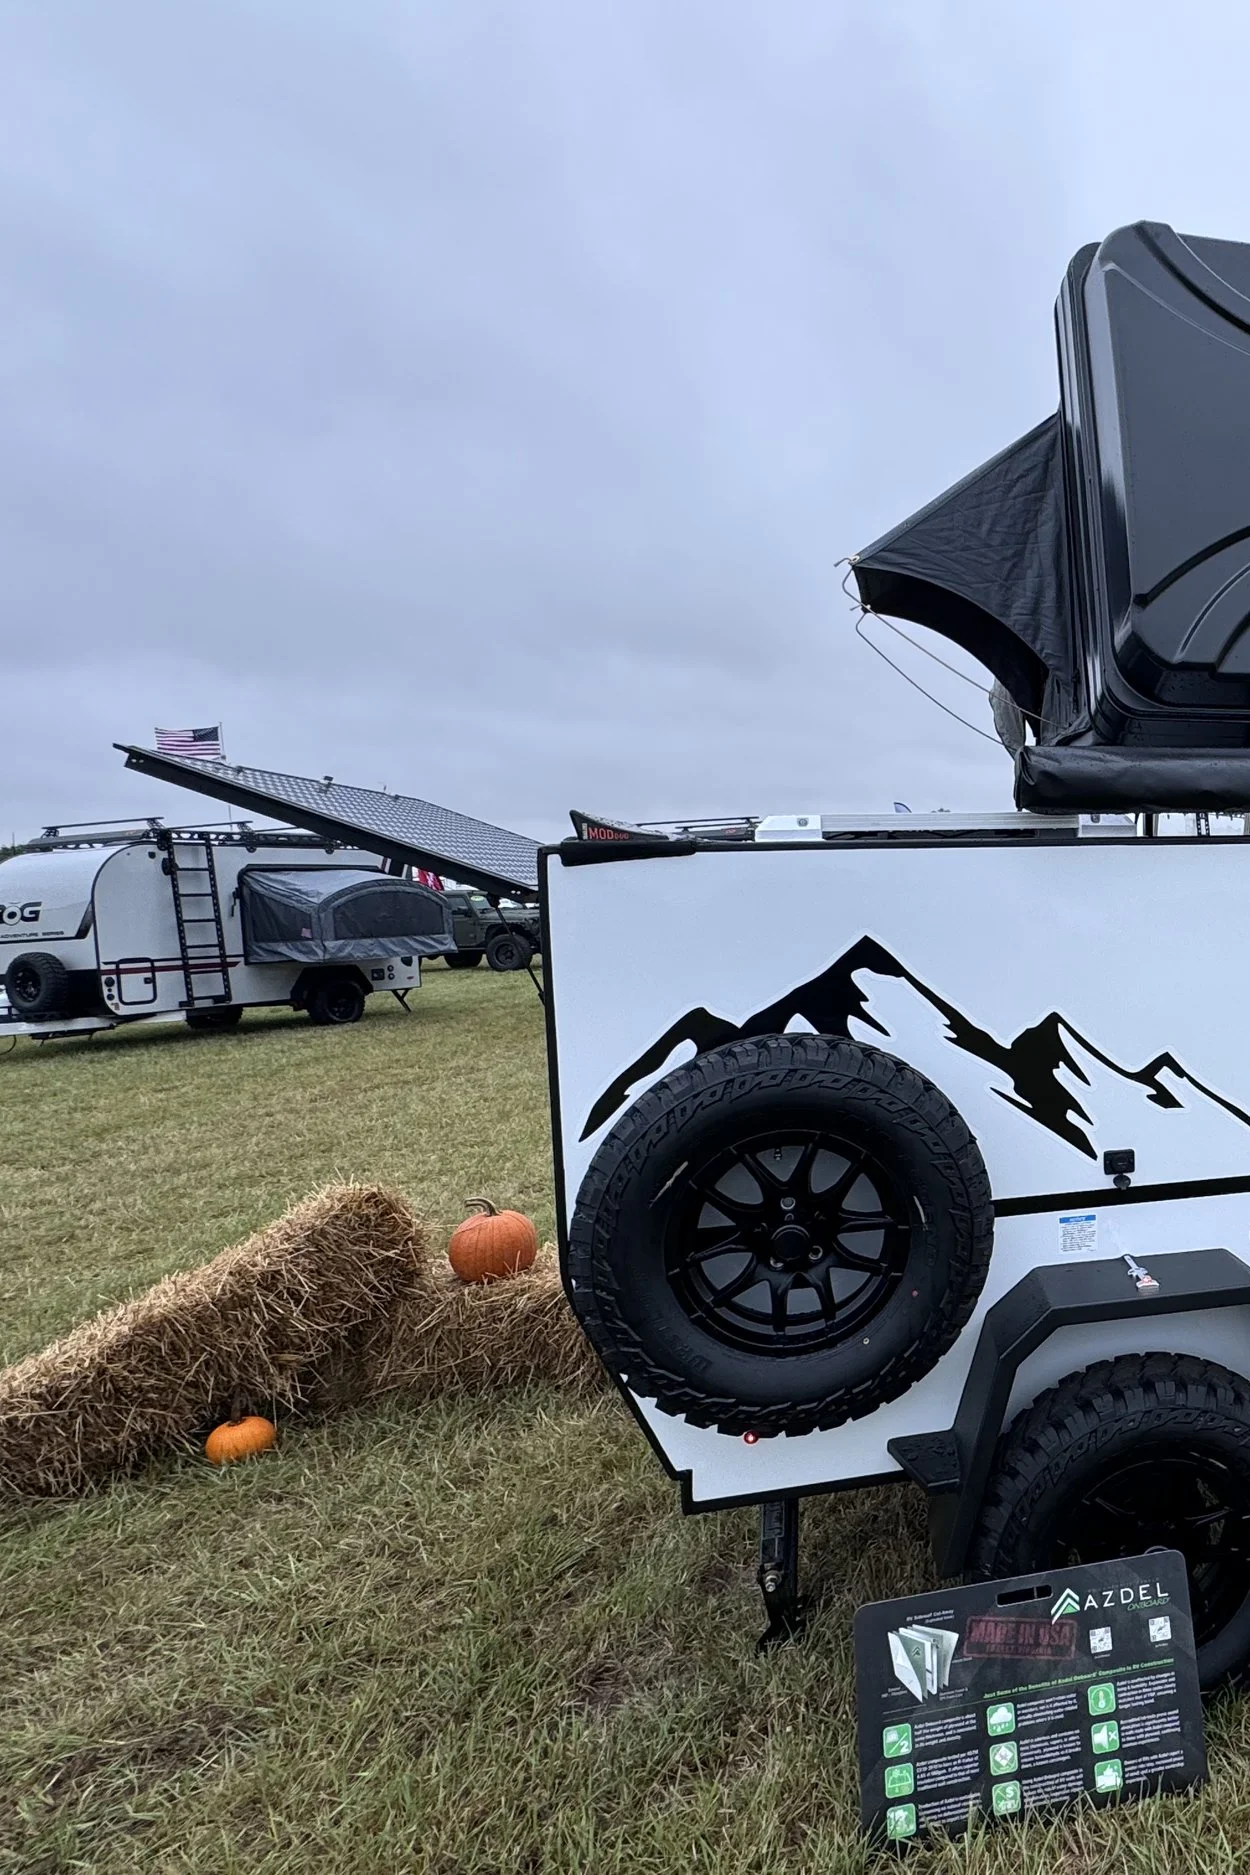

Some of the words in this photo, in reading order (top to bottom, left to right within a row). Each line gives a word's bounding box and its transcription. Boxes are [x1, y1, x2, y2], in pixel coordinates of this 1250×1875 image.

[588, 827, 614, 840] MOD
[1084, 1582, 1169, 1611] AZDEL
[970, 1621, 1016, 1643] MADE
[1018, 1623, 1036, 1645] IN
[1039, 1624, 1070, 1646] USA
